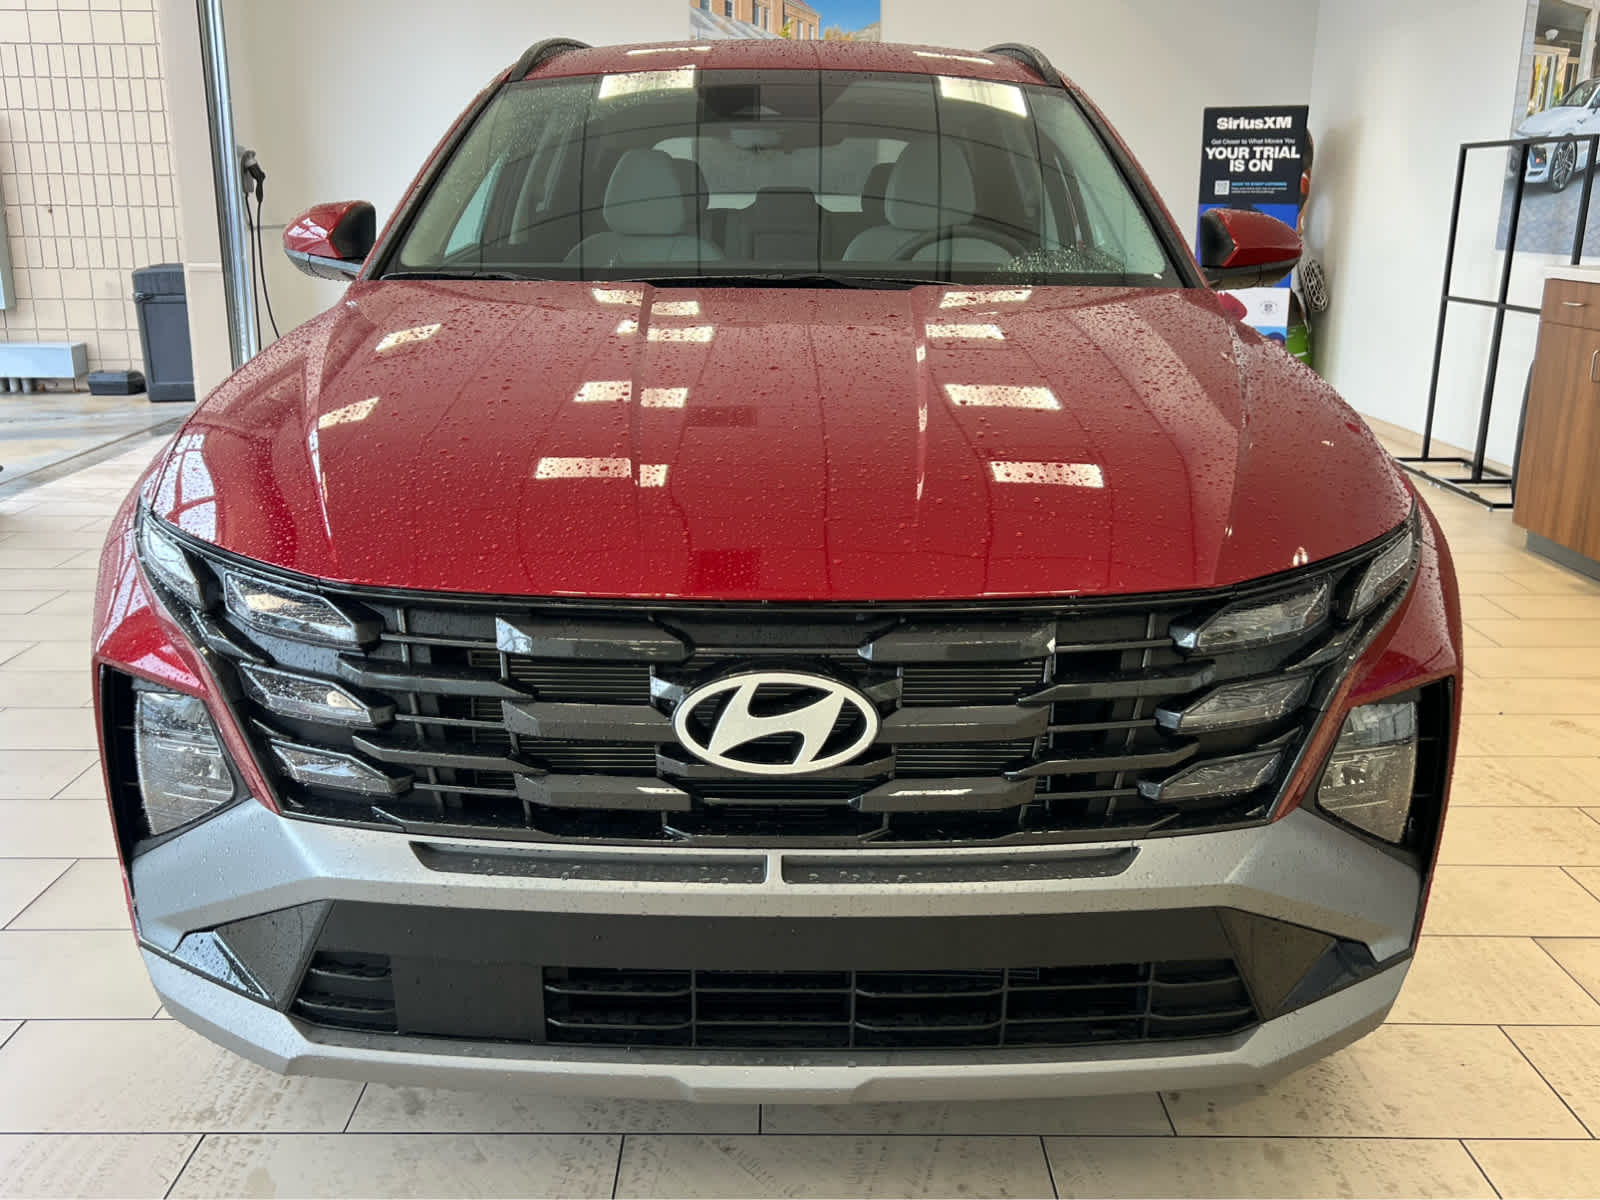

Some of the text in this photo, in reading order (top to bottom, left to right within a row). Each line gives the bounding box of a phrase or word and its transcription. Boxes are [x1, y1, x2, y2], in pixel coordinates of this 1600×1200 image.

[1216, 116, 1292, 130] SiriusXM
[1205, 146, 1300, 159] YOUR TRIAL
[1229, 159, 1273, 172] IS ON
